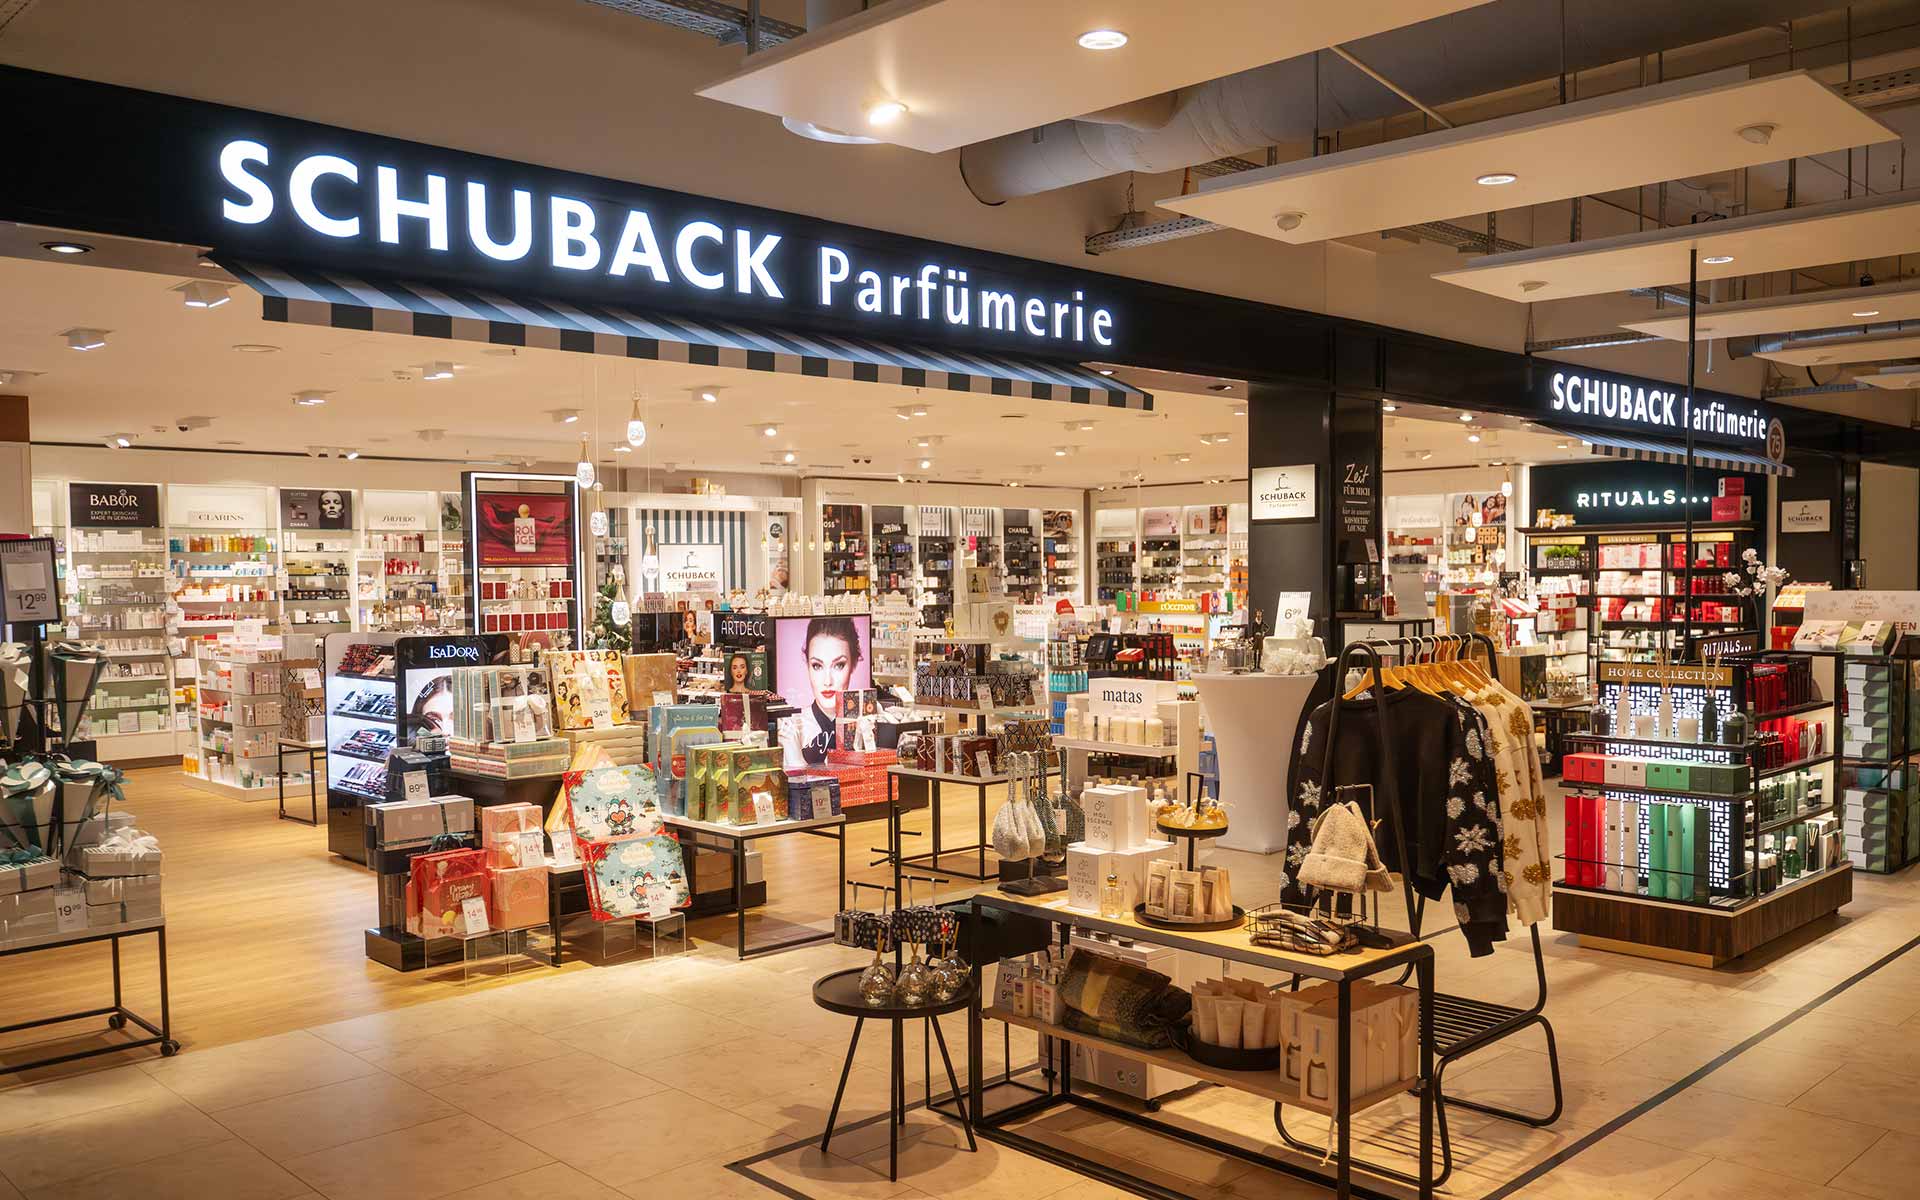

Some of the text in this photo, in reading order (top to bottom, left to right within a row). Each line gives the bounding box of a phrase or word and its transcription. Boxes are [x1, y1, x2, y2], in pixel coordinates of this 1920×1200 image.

[219, 139, 1113, 346] SCHUBACK Parfümerie
[1552, 373, 1676, 426] SCHUBACK
[1344, 464, 1369, 484] Zeit
[1260, 491, 1306, 501] SCHUBACK
[1343, 485, 1371, 496] FÜR MICH
[1008, 527, 1029, 535] CHANEL
[667, 571, 716, 580] SCHUBACK
[1608, 667, 1643, 679] HOME
[1103, 689, 1143, 704] matas
